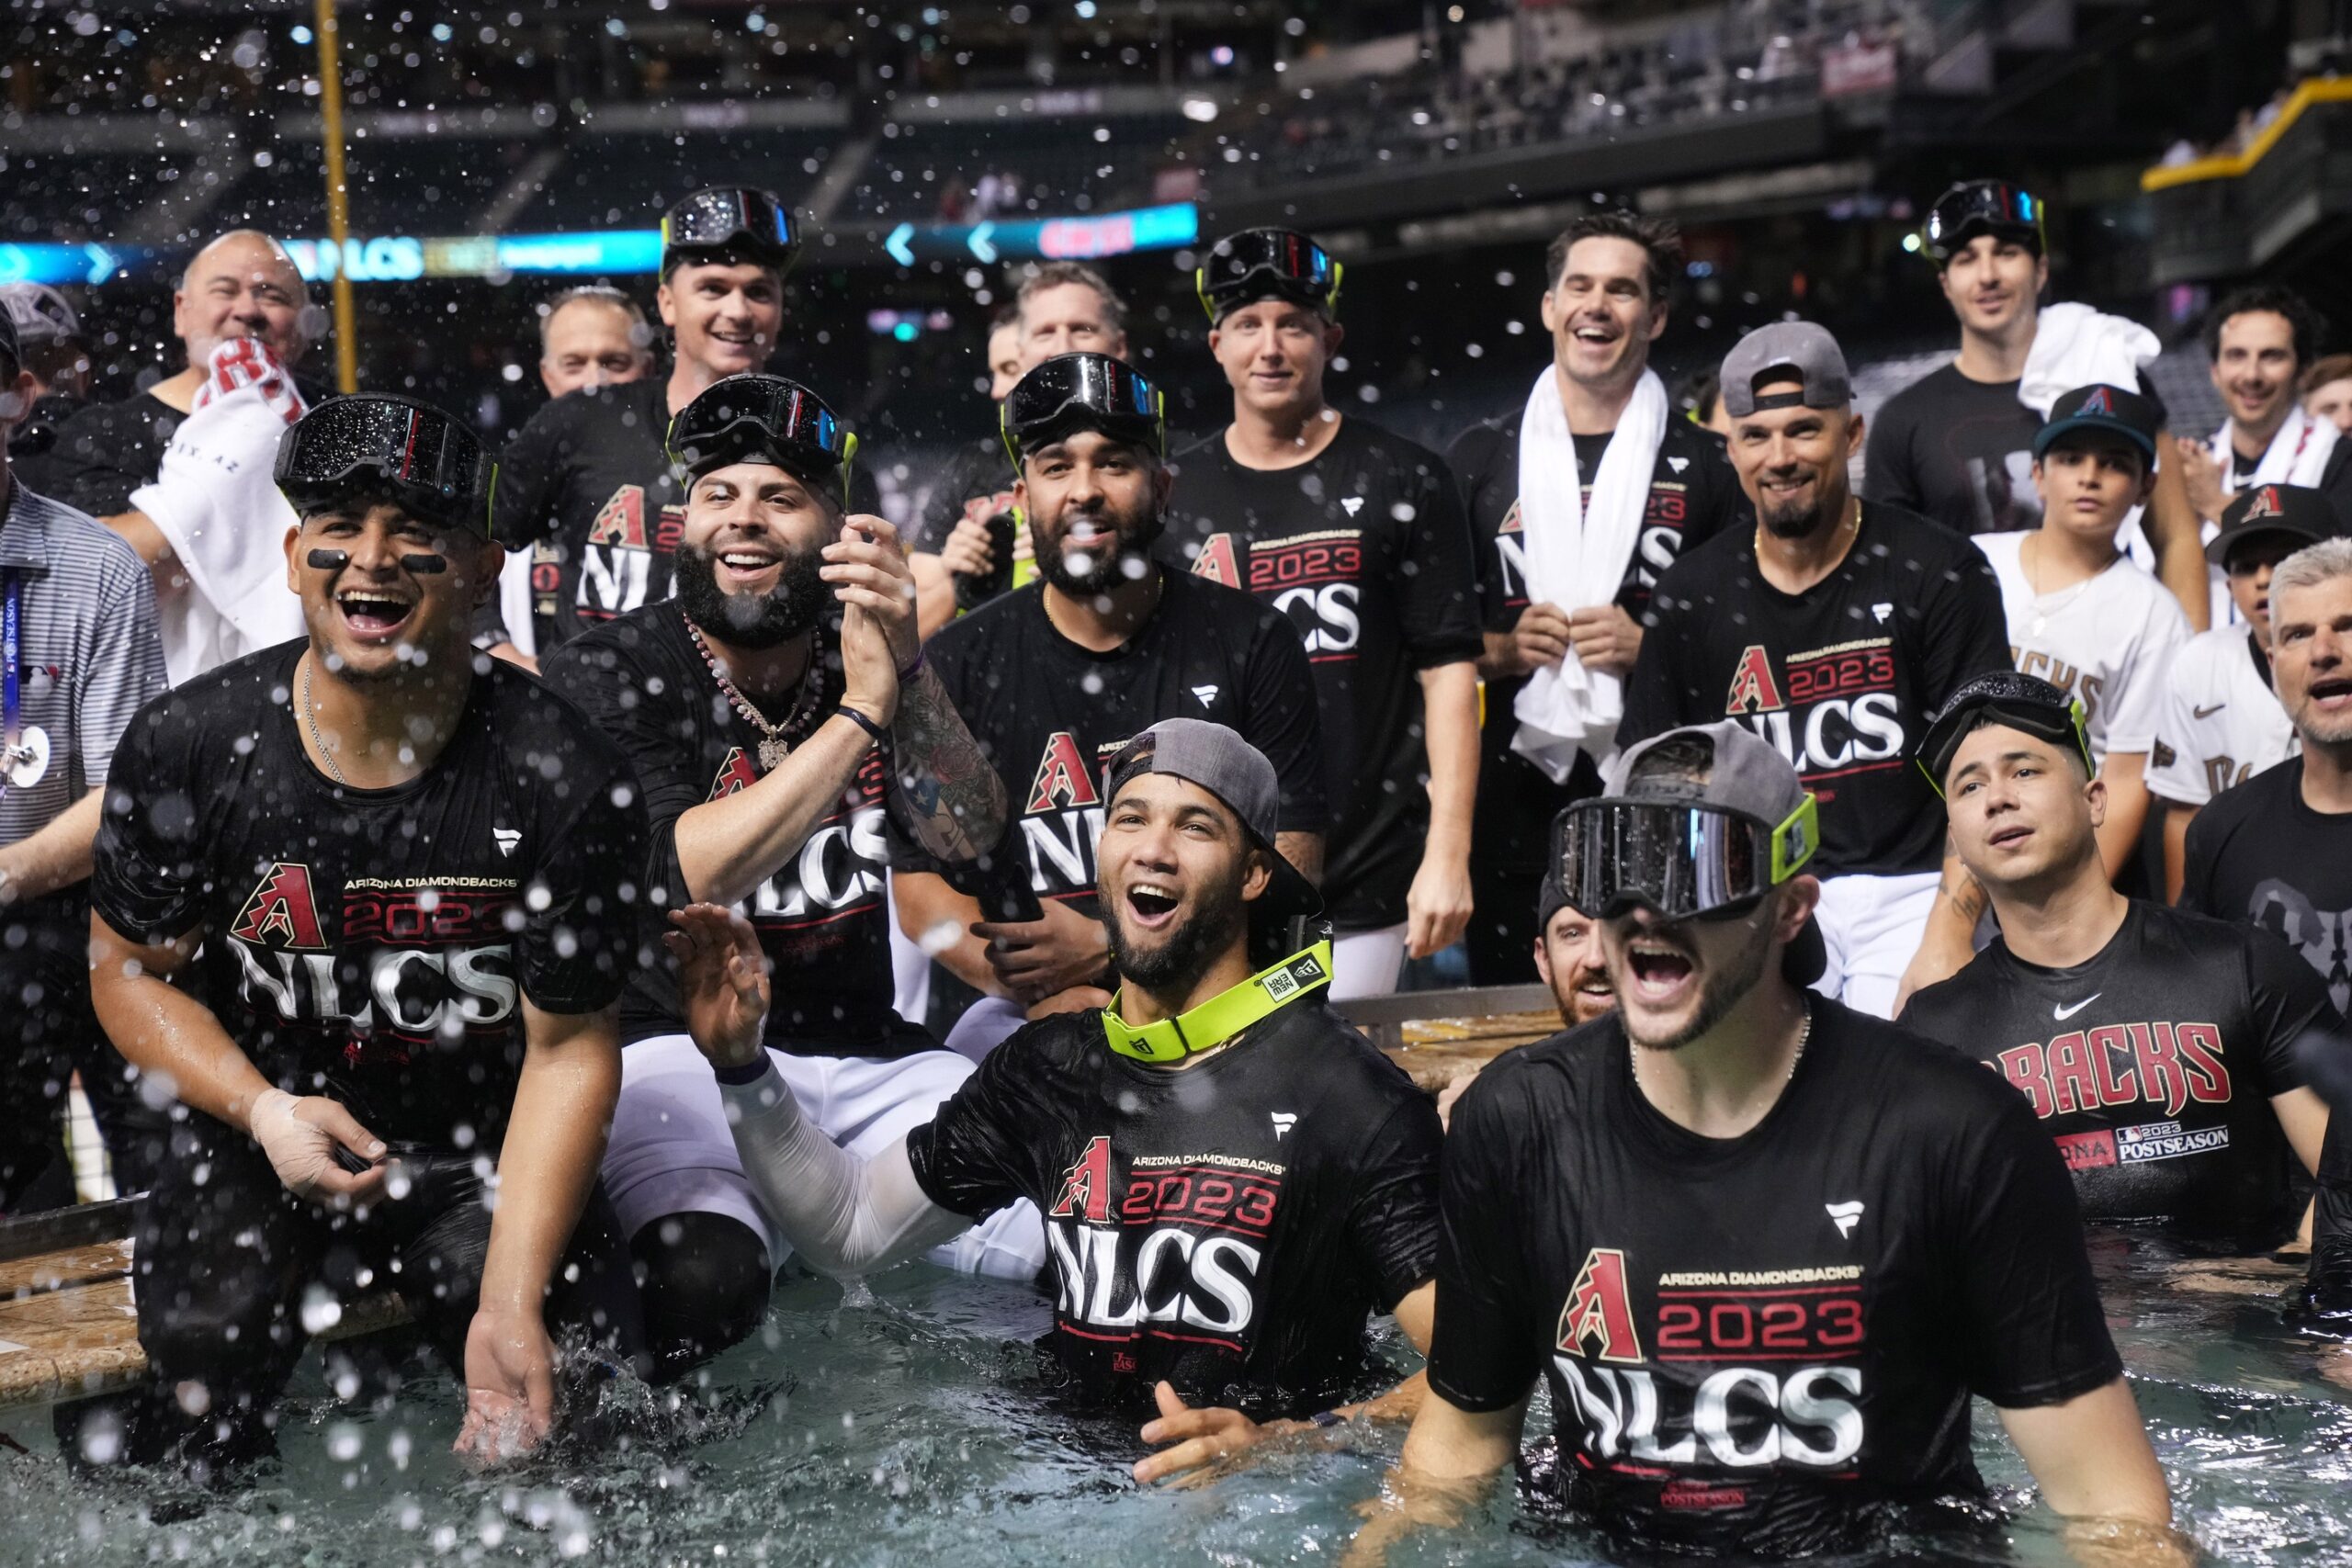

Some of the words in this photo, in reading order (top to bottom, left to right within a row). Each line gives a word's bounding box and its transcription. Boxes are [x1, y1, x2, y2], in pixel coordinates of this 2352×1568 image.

[588, 483, 650, 550] A
[2241, 485, 2284, 524] A
[1250, 547, 1360, 584] 2023
[6, 598, 15, 663] POSTSEASON
[1725, 645, 1785, 715] A
[1789, 656, 1894, 697] 2023
[1024, 732, 1102, 814] A
[230, 862, 327, 949] A
[345, 878, 403, 890] ARIZONA
[405, 876, 518, 888] DIAMONDBACKS
[227, 935, 516, 1032] NLCS
[1268, 974, 1289, 988] ERA
[1272, 980, 1294, 996] NEW
[1981, 1021, 2231, 1119] BACKS
[2120, 1129, 2229, 1160] POSTSEASON
[2142, 1124, 2182, 1137] 2023
[1048, 1135, 1112, 1224] A
[1132, 1156, 1182, 1167] ARIZONA
[1183, 1154, 1283, 1176] DIAMONDBACKS
[1123, 1177, 1277, 1226] 2023
[1047, 1221, 1261, 1333] NLCS
[1659, 1271, 1728, 1286] ARIZONA
[1729, 1265, 1860, 1286] DIAMONDBACKS
[1555, 1247, 1643, 1363] A
[1657, 1300, 1863, 1348] 2023
[1553, 1355, 1863, 1467] NLCS
